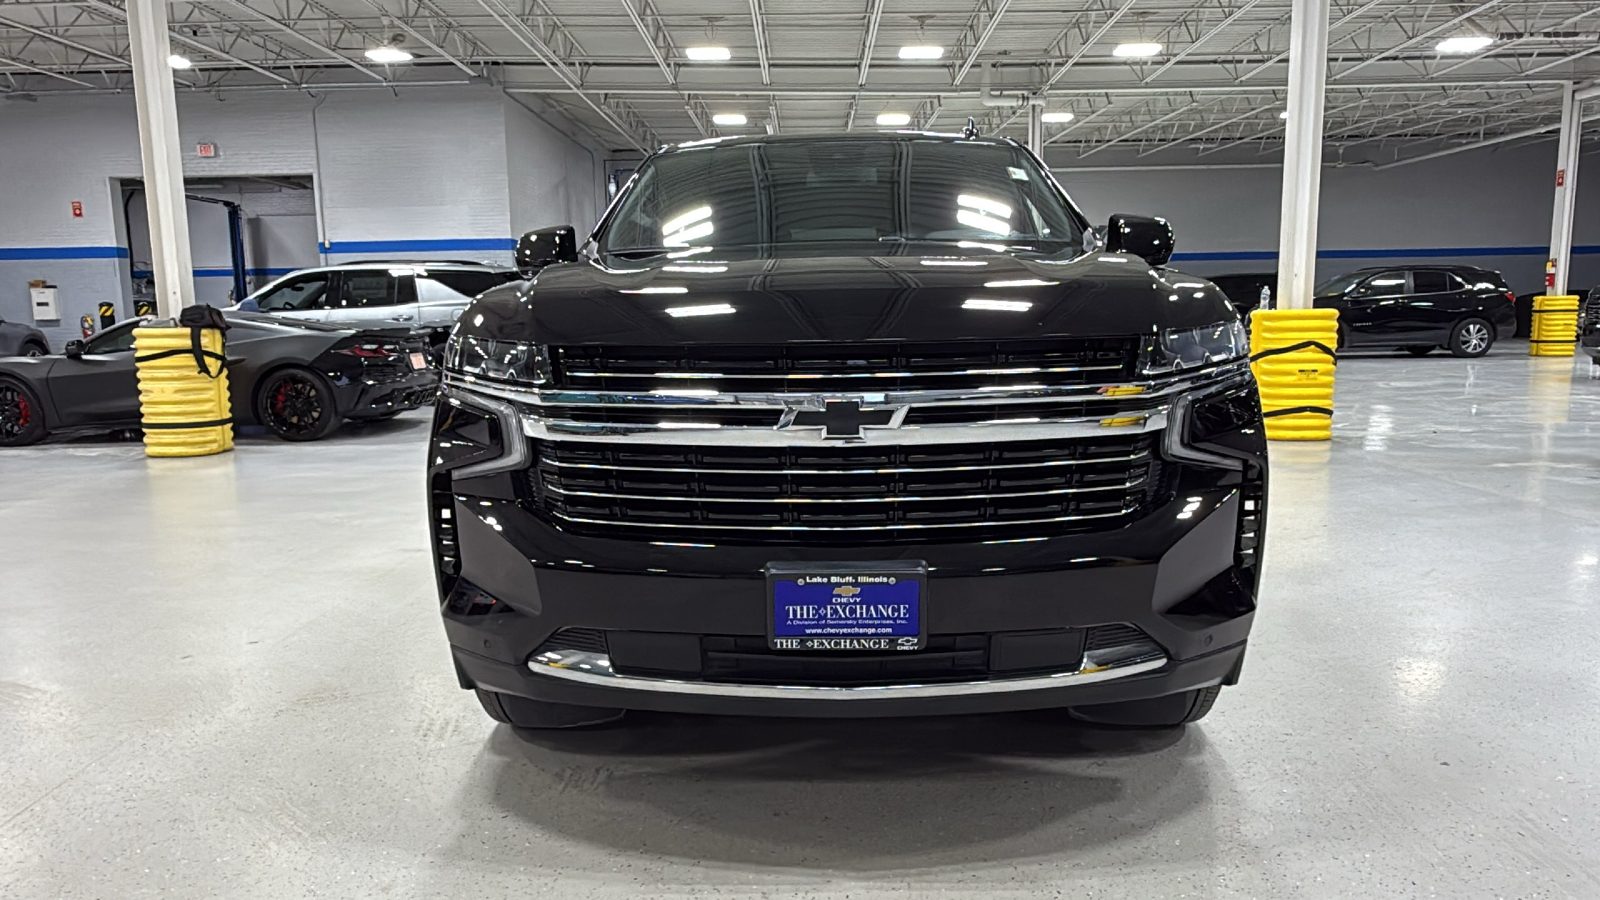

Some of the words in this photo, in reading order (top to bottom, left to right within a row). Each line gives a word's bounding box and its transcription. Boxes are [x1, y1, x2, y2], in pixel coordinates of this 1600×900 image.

[785, 605, 818, 619] THE
[826, 604, 909, 618] EXCHANGE
[805, 627, 893, 635] www.chevyexchange.com
[774, 639, 800, 649] THE
[813, 639, 889, 649] EXCHANGE
